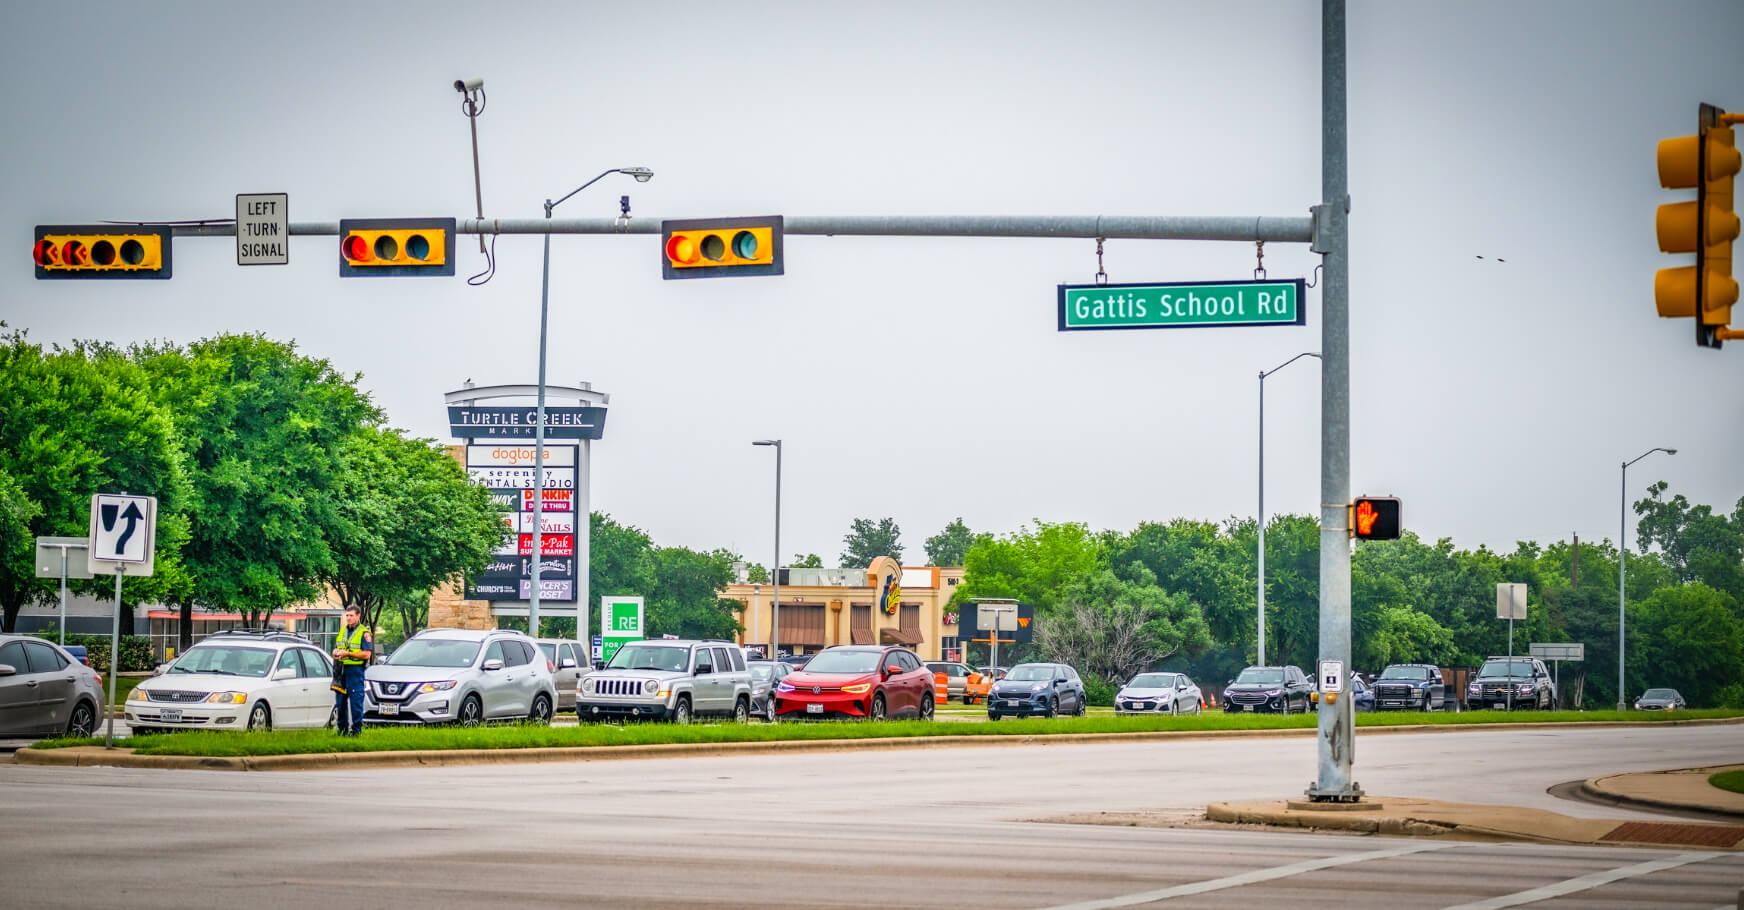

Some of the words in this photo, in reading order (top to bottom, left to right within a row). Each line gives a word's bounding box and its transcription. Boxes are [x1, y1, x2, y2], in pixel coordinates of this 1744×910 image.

[248, 202, 276, 215] LEFT
[246, 222, 278, 236] TURN
[241, 243, 285, 257] SIGNAL
[1074, 293, 1147, 319] Gattis
[1160, 291, 1244, 317] School
[1257, 290, 1287, 314] Rd
[461, 411, 519, 425] TURTLE
[492, 448, 550, 464] dogtopa
[525, 490, 573, 500] DNKIN'
[524, 535, 569, 548] ino-Pak
[524, 581, 569, 590] DNCER'S
[619, 616, 637, 630] RE
